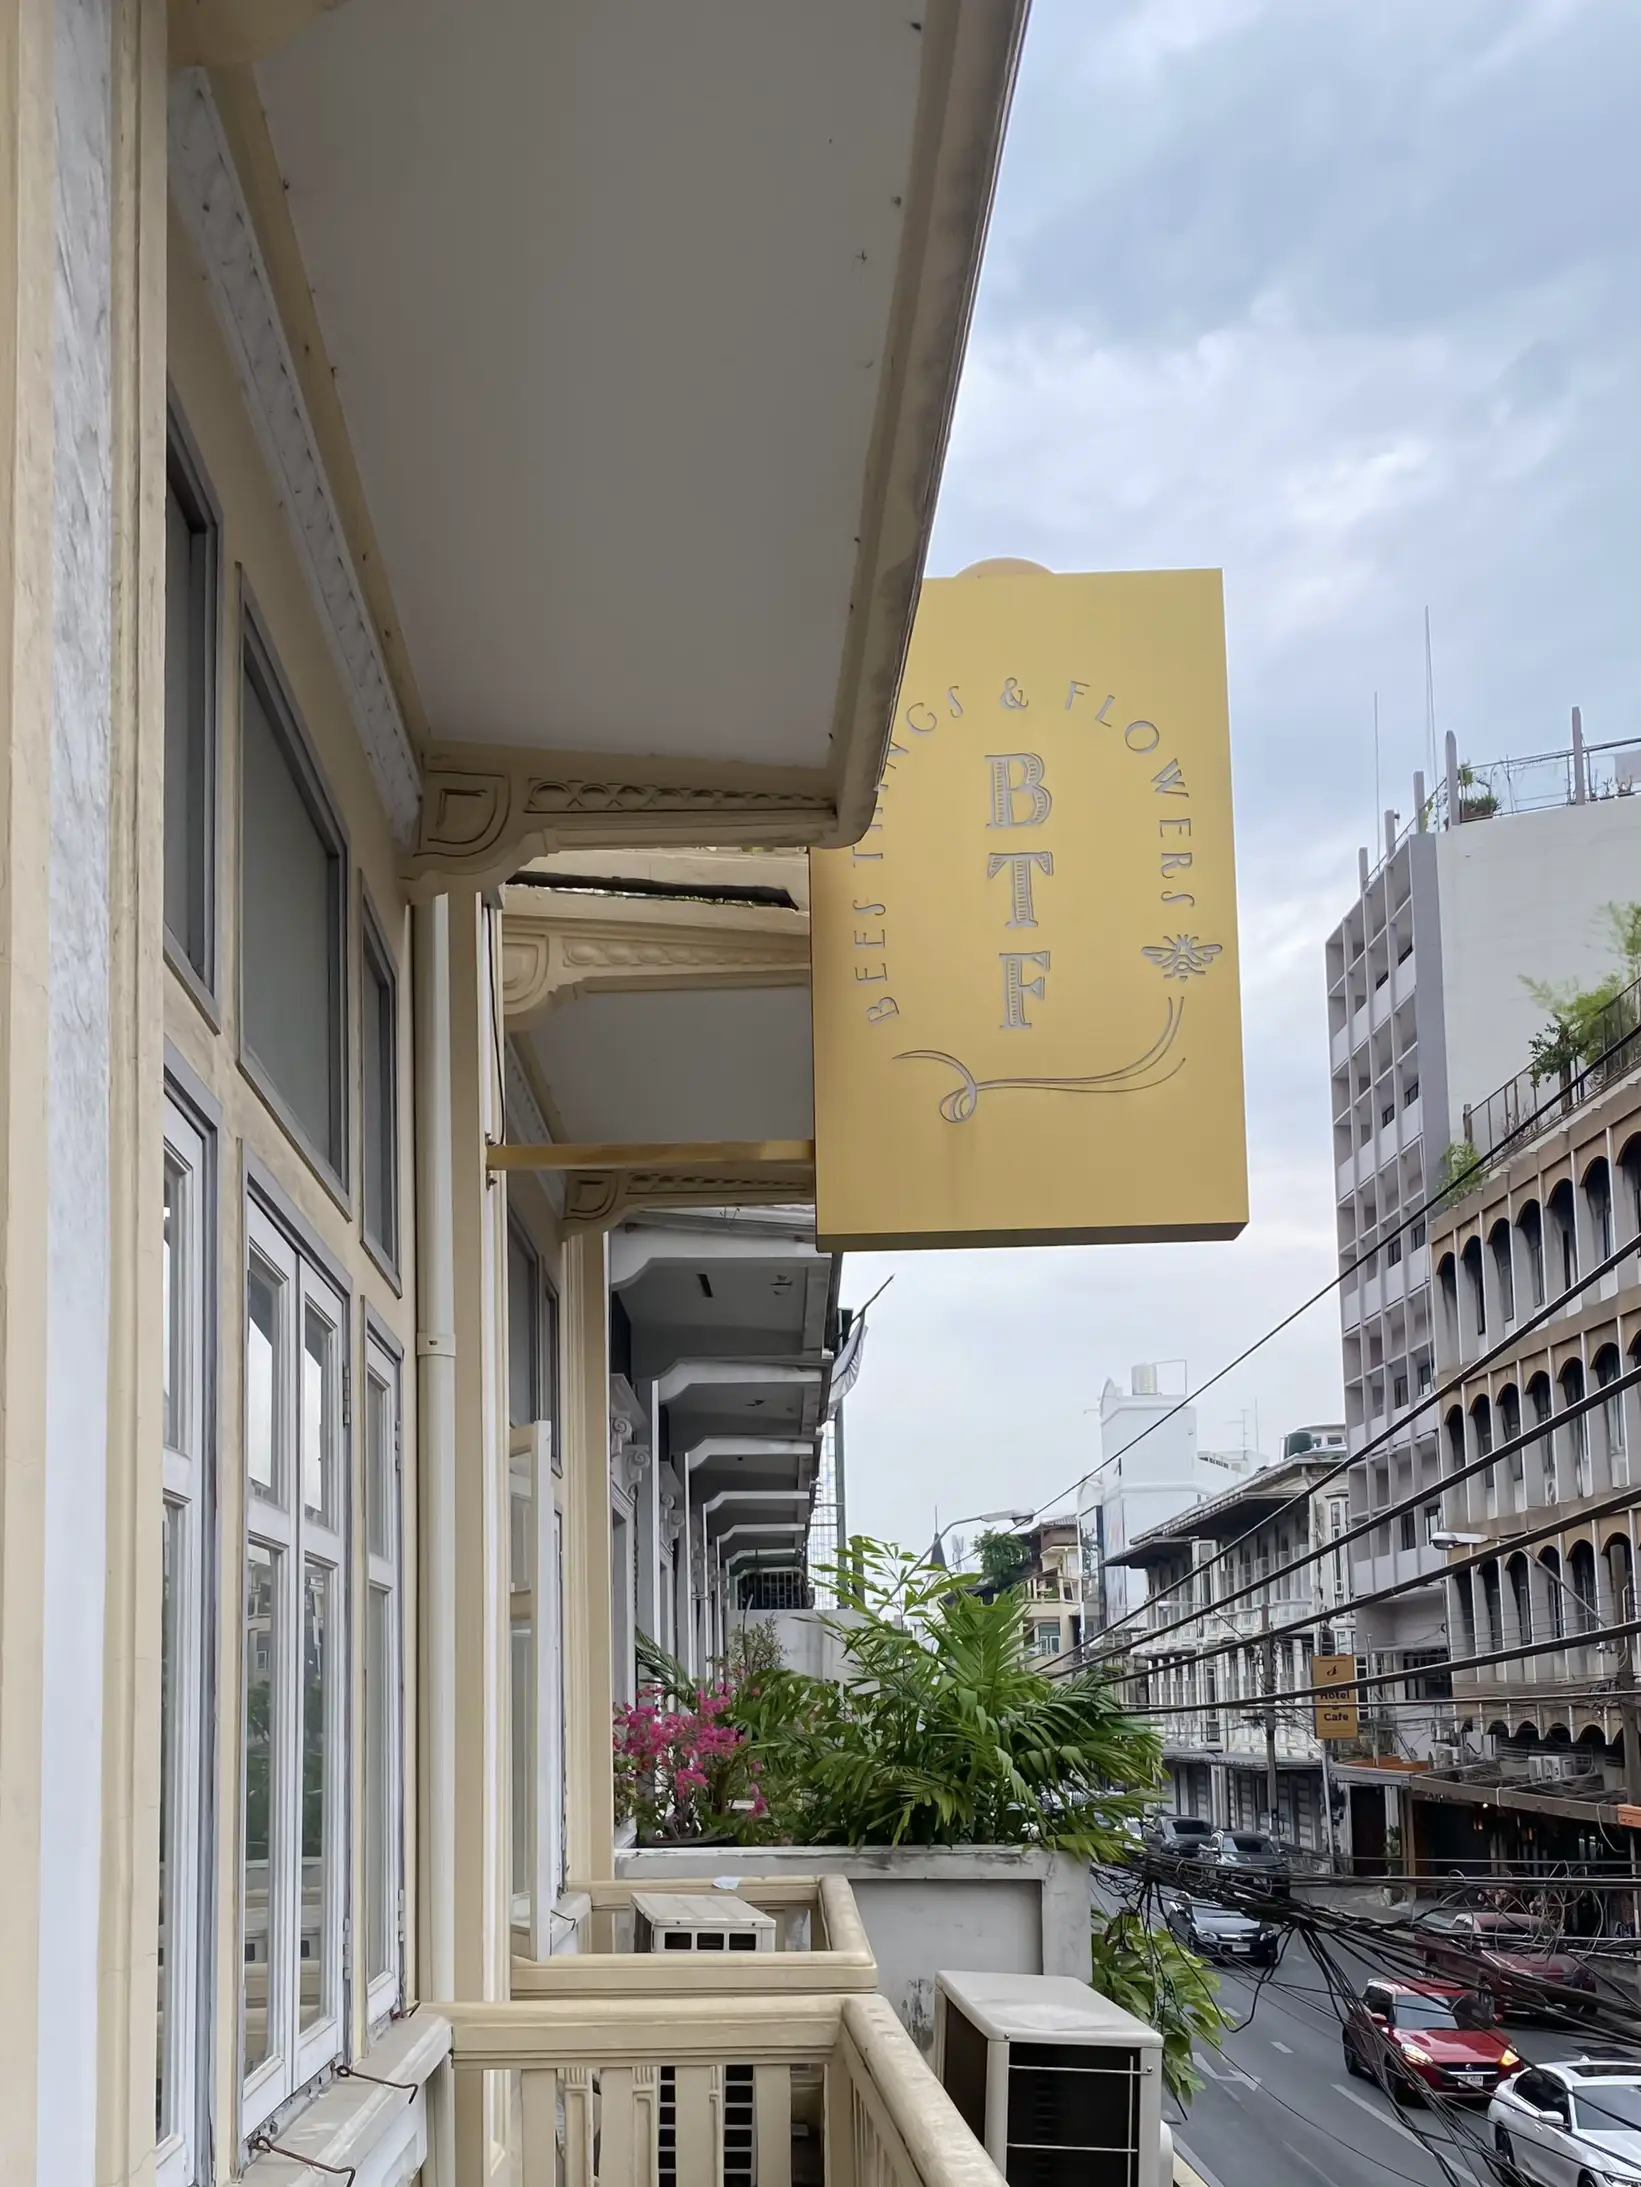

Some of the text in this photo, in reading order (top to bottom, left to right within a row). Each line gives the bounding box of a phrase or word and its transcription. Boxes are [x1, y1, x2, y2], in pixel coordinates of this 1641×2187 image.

[853, 899, 900, 1024] BEES
[1000, 677, 1029, 710] &
[1066, 680, 1194, 908] FLOWERS
